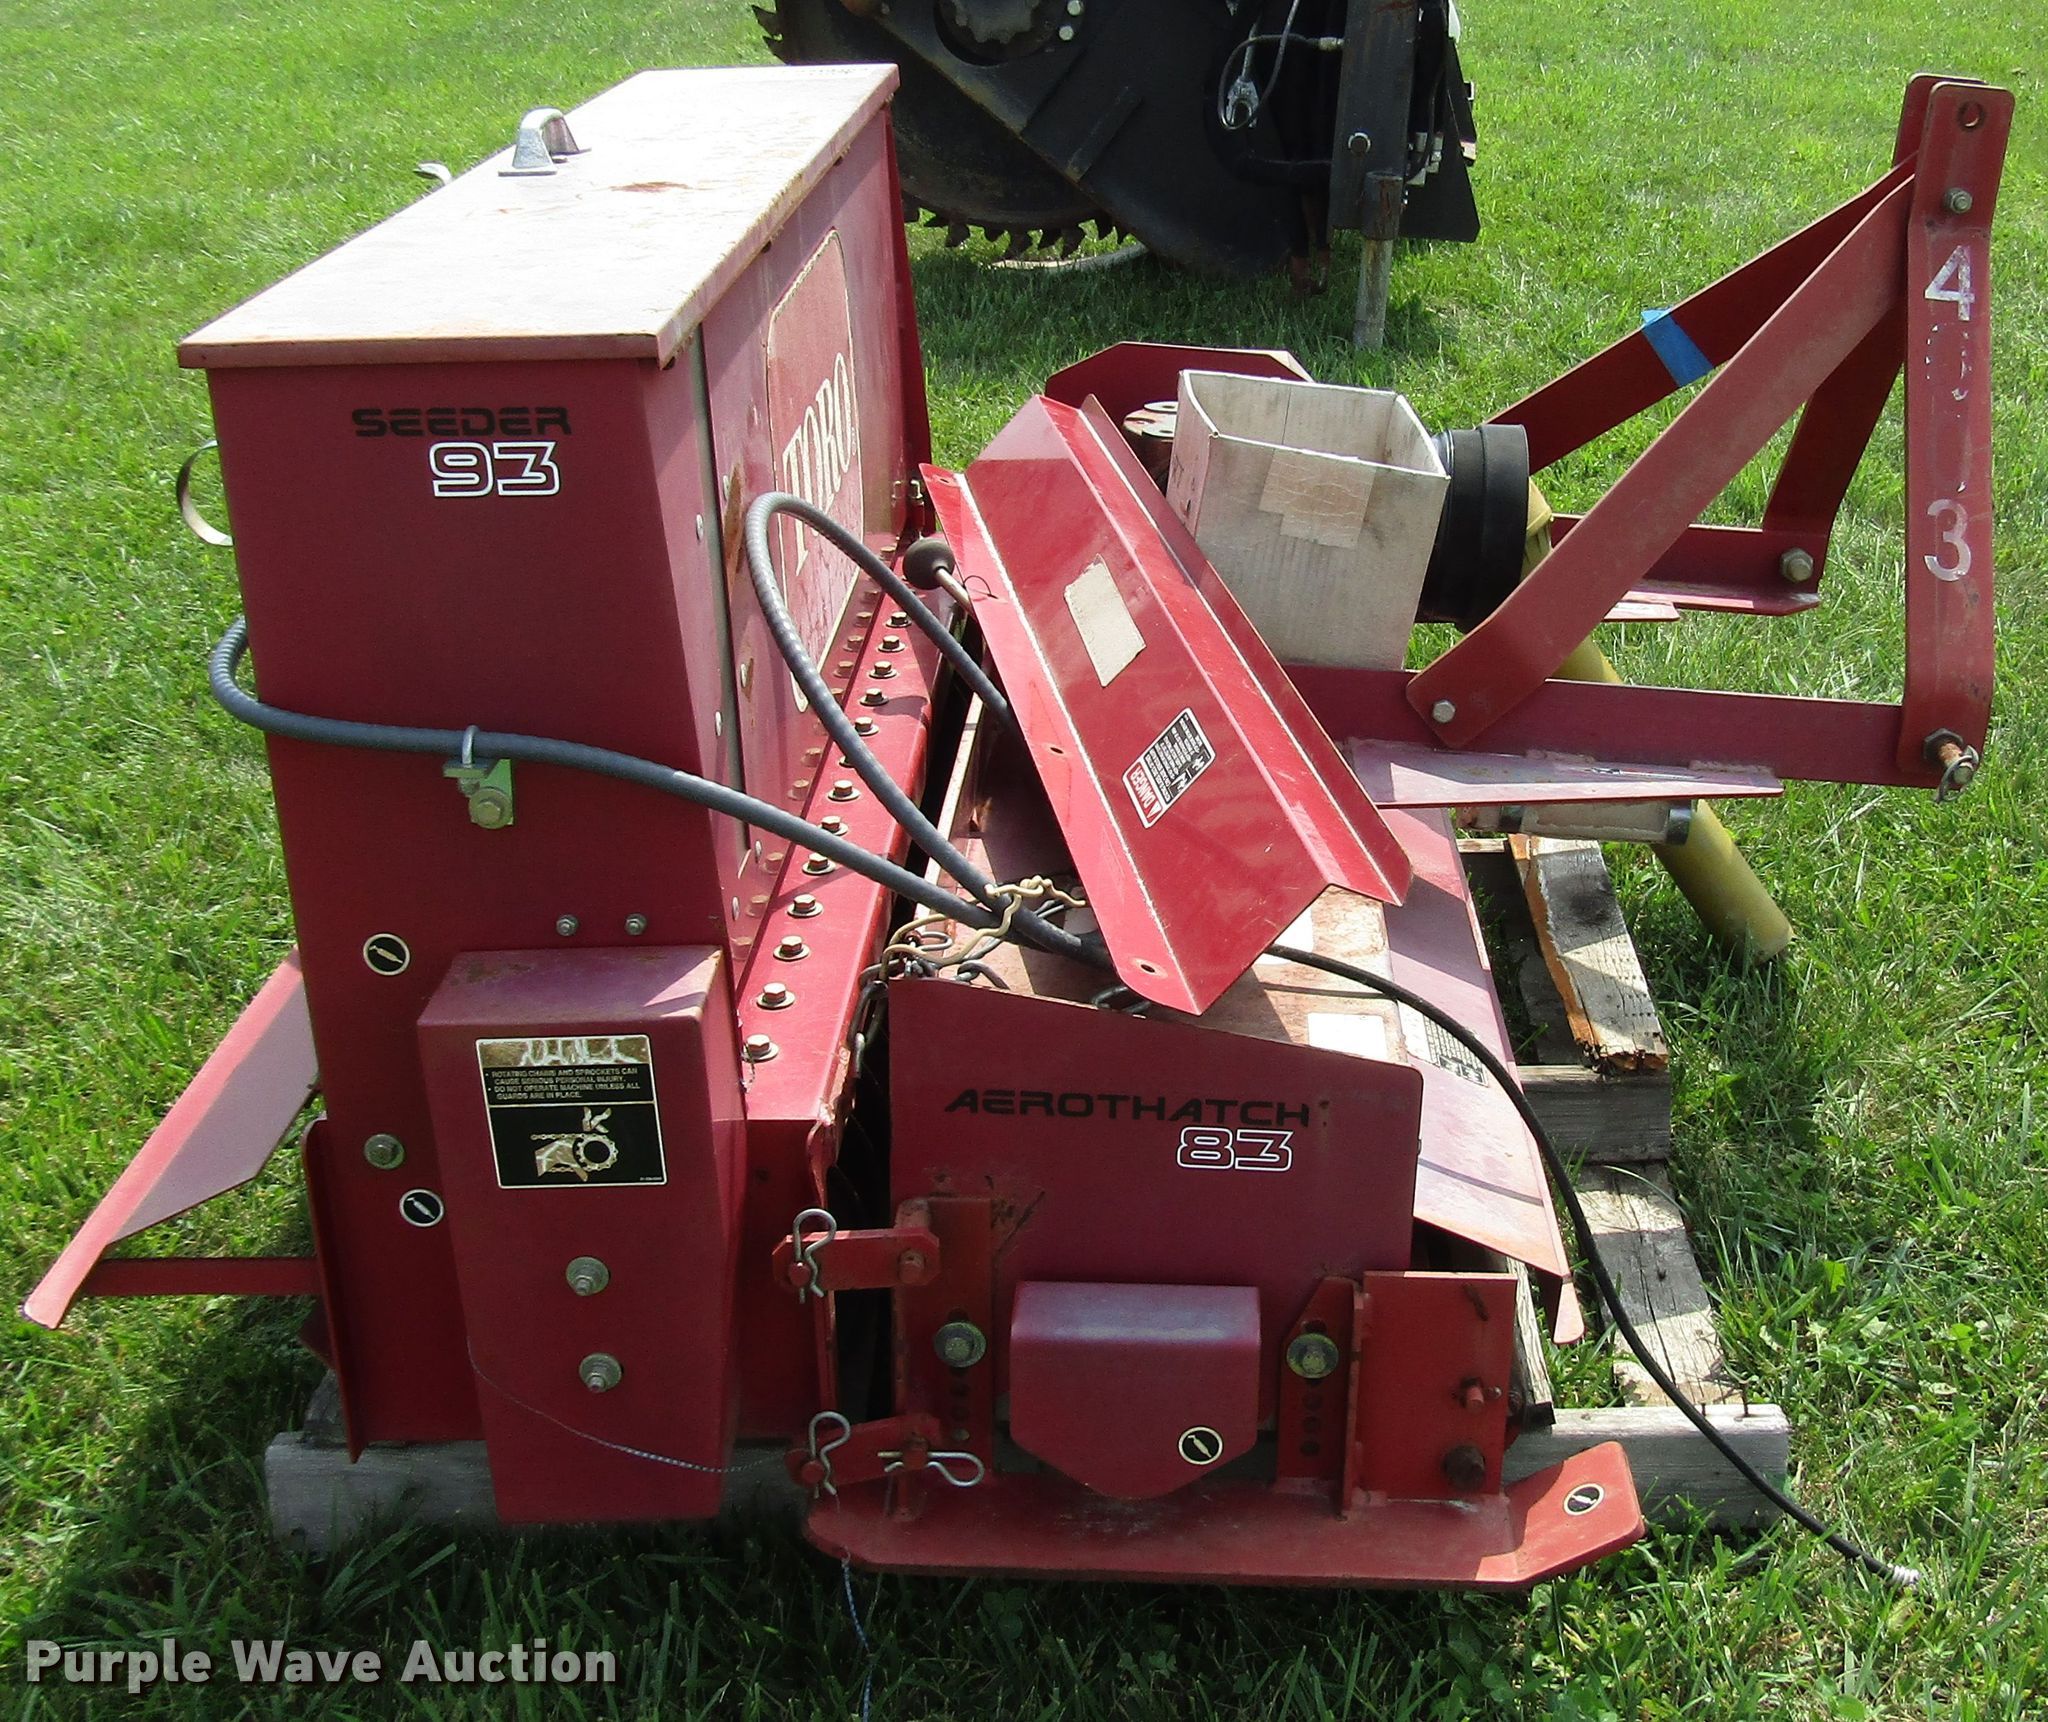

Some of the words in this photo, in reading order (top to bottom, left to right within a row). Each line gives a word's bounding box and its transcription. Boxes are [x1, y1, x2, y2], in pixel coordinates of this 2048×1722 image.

[1924, 245, 1975, 321] 4
[352, 406, 572, 437] SEEDER
[428, 441, 562, 498] 93
[1924, 499, 1972, 582] 3
[1130, 764, 1157, 809] DANGER
[491, 1070, 528, 1078] ROTATING
[621, 1067, 638, 1075] CAN
[494, 1078, 521, 1086] CAUSE
[521, 1077, 554, 1085] SERIOUS
[555, 1076, 596, 1084] PERSONAL
[494, 1085, 506, 1093] DO
[523, 1084, 559, 1092] OPERATE
[560, 1083, 594, 1091] MACHINE
[595, 1082, 625, 1090] UNLESS
[626, 1081, 641, 1089] ALL
[496, 1092, 529, 1100] GUARDS
[529, 1092, 545, 1100] ARE
[546, 1091, 555, 1099] IN
[944, 1088, 1311, 1128] AEROTHATCH
[1176, 1126, 1294, 1173] 83
